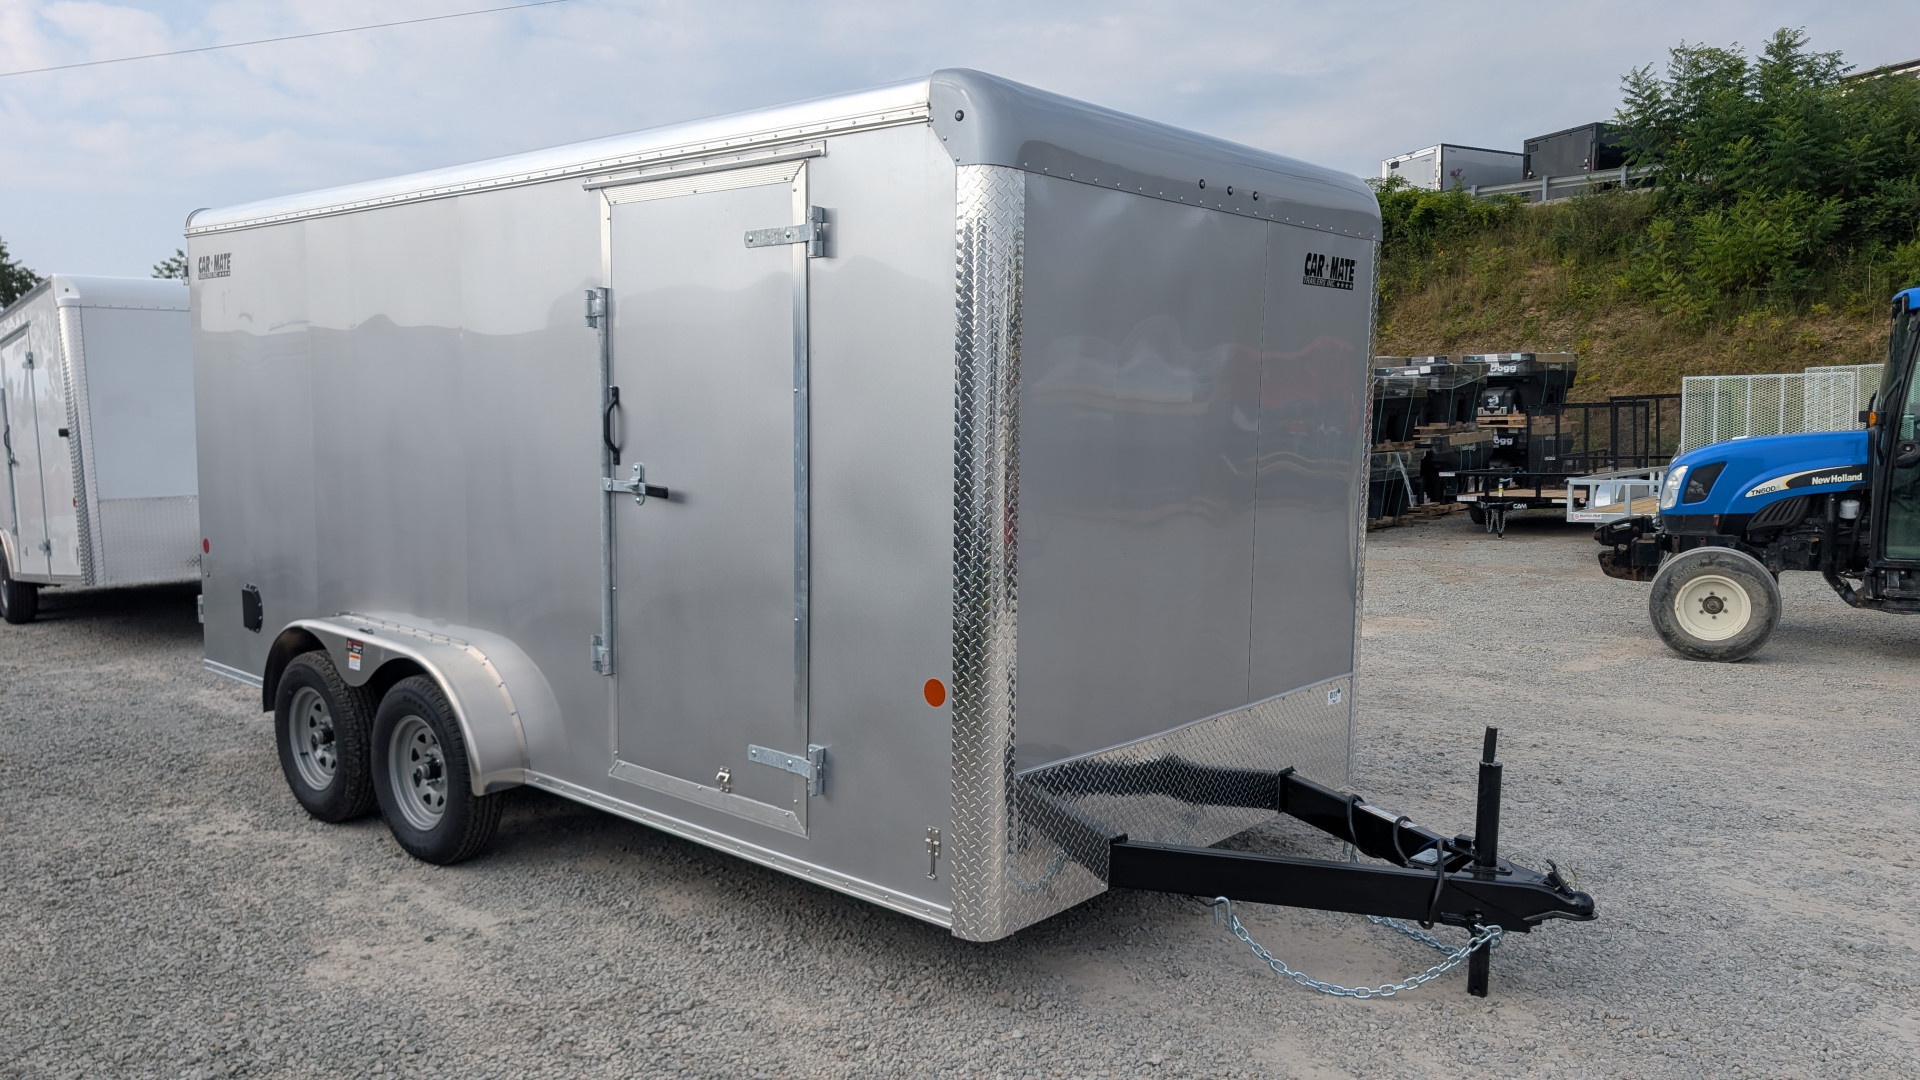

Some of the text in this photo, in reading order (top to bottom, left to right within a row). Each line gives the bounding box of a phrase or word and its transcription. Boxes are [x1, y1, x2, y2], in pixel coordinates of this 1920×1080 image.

[198, 253, 231, 273] CAR MATE
[1304, 252, 1356, 282] CAR MATE
[1812, 473, 1862, 485] New Holland
